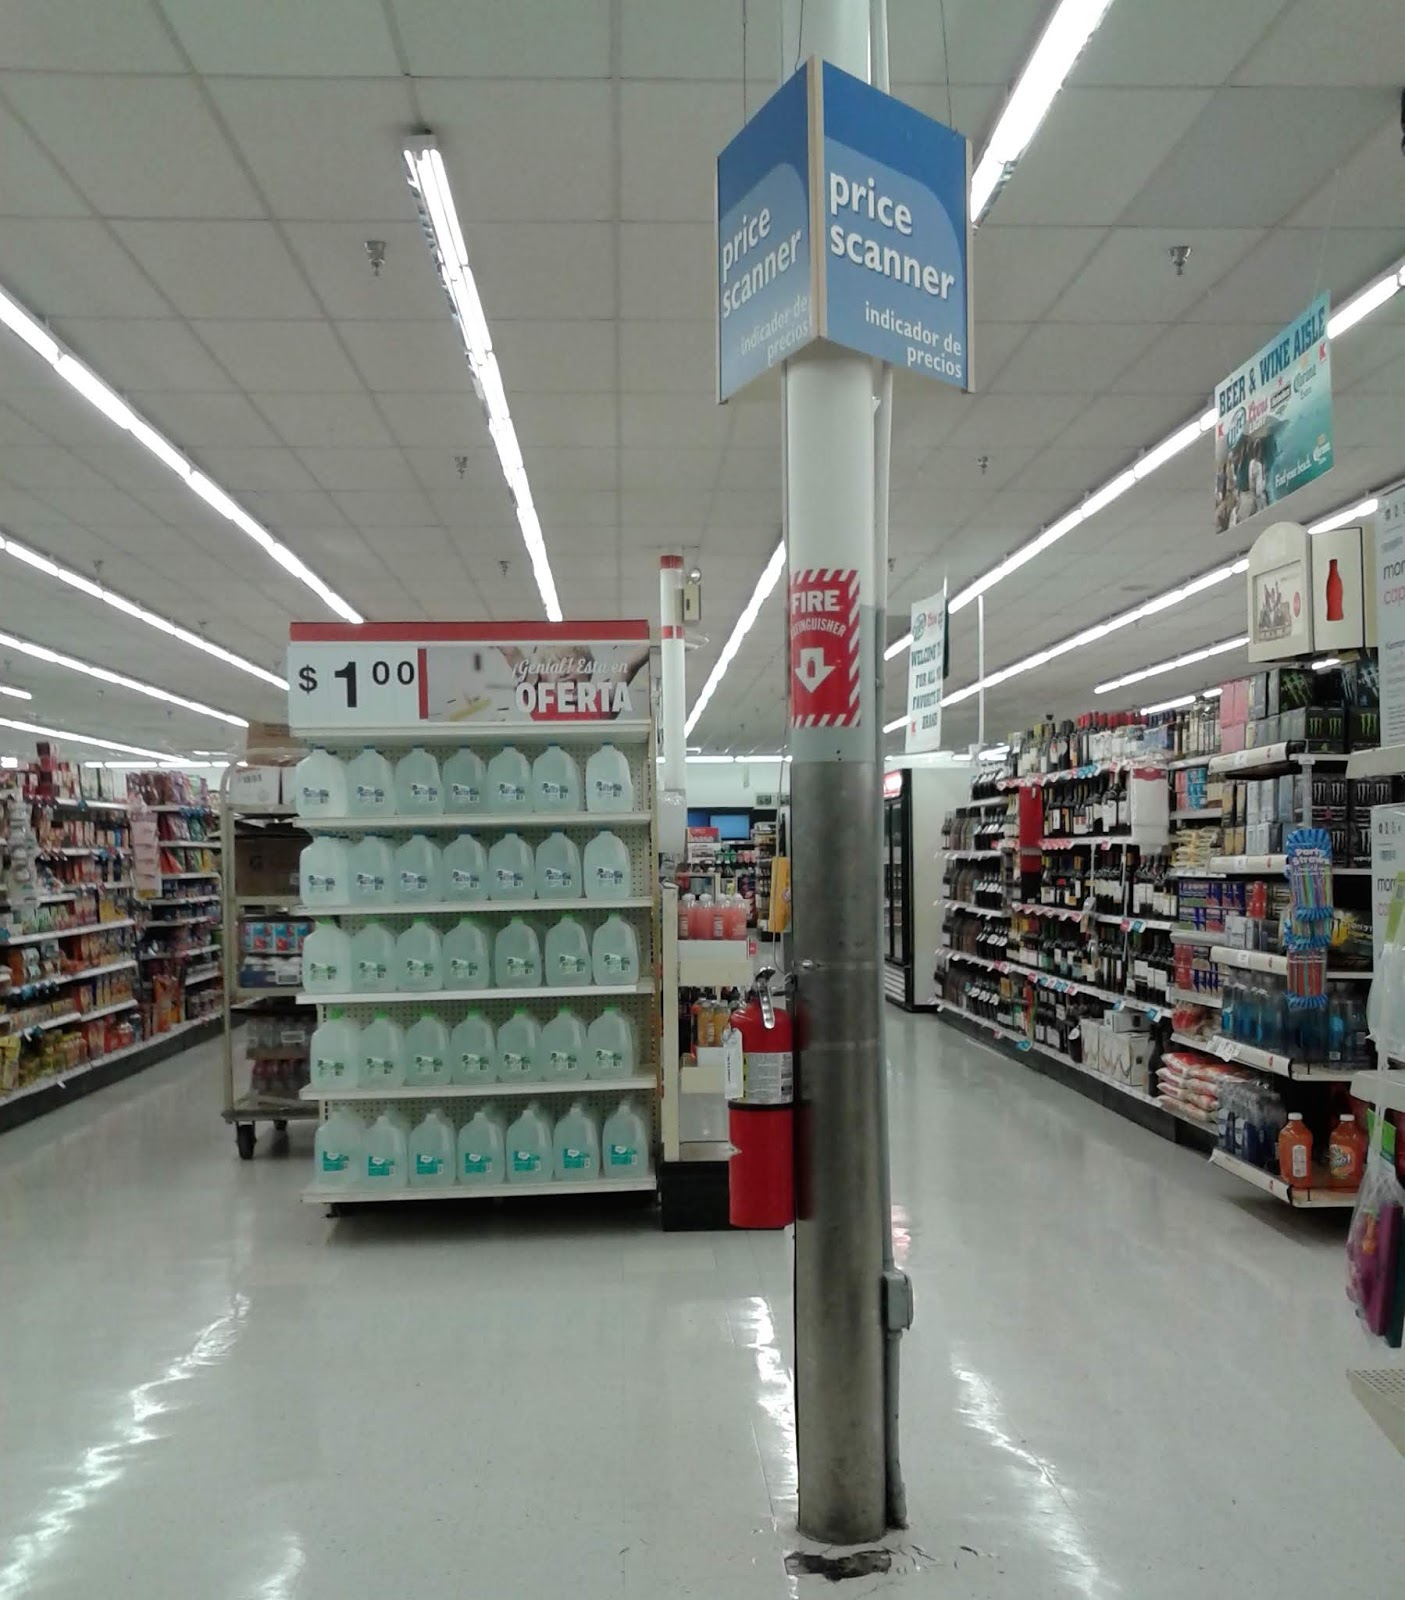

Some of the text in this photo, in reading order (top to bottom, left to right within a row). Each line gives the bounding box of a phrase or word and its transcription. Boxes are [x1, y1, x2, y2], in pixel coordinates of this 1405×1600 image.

[830, 172, 913, 235] price
[722, 207, 772, 283] price
[830, 226, 955, 300] scanner
[722, 231, 802, 318] scanner
[741, 308, 791, 356] indicador
[865, 300, 962, 356] indicador de
[907, 347, 963, 379] precios
[1219, 375, 1246, 419] BEER
[1260, 337, 1290, 386] WINE
[1293, 305, 1326, 361] AISLE
[792, 589, 840, 615] FIRE
[298, 664, 318, 694] $
[334, 661, 357, 708] 1
[611, 661, 628, 673] en
[515, 681, 633, 713] OFERTA
